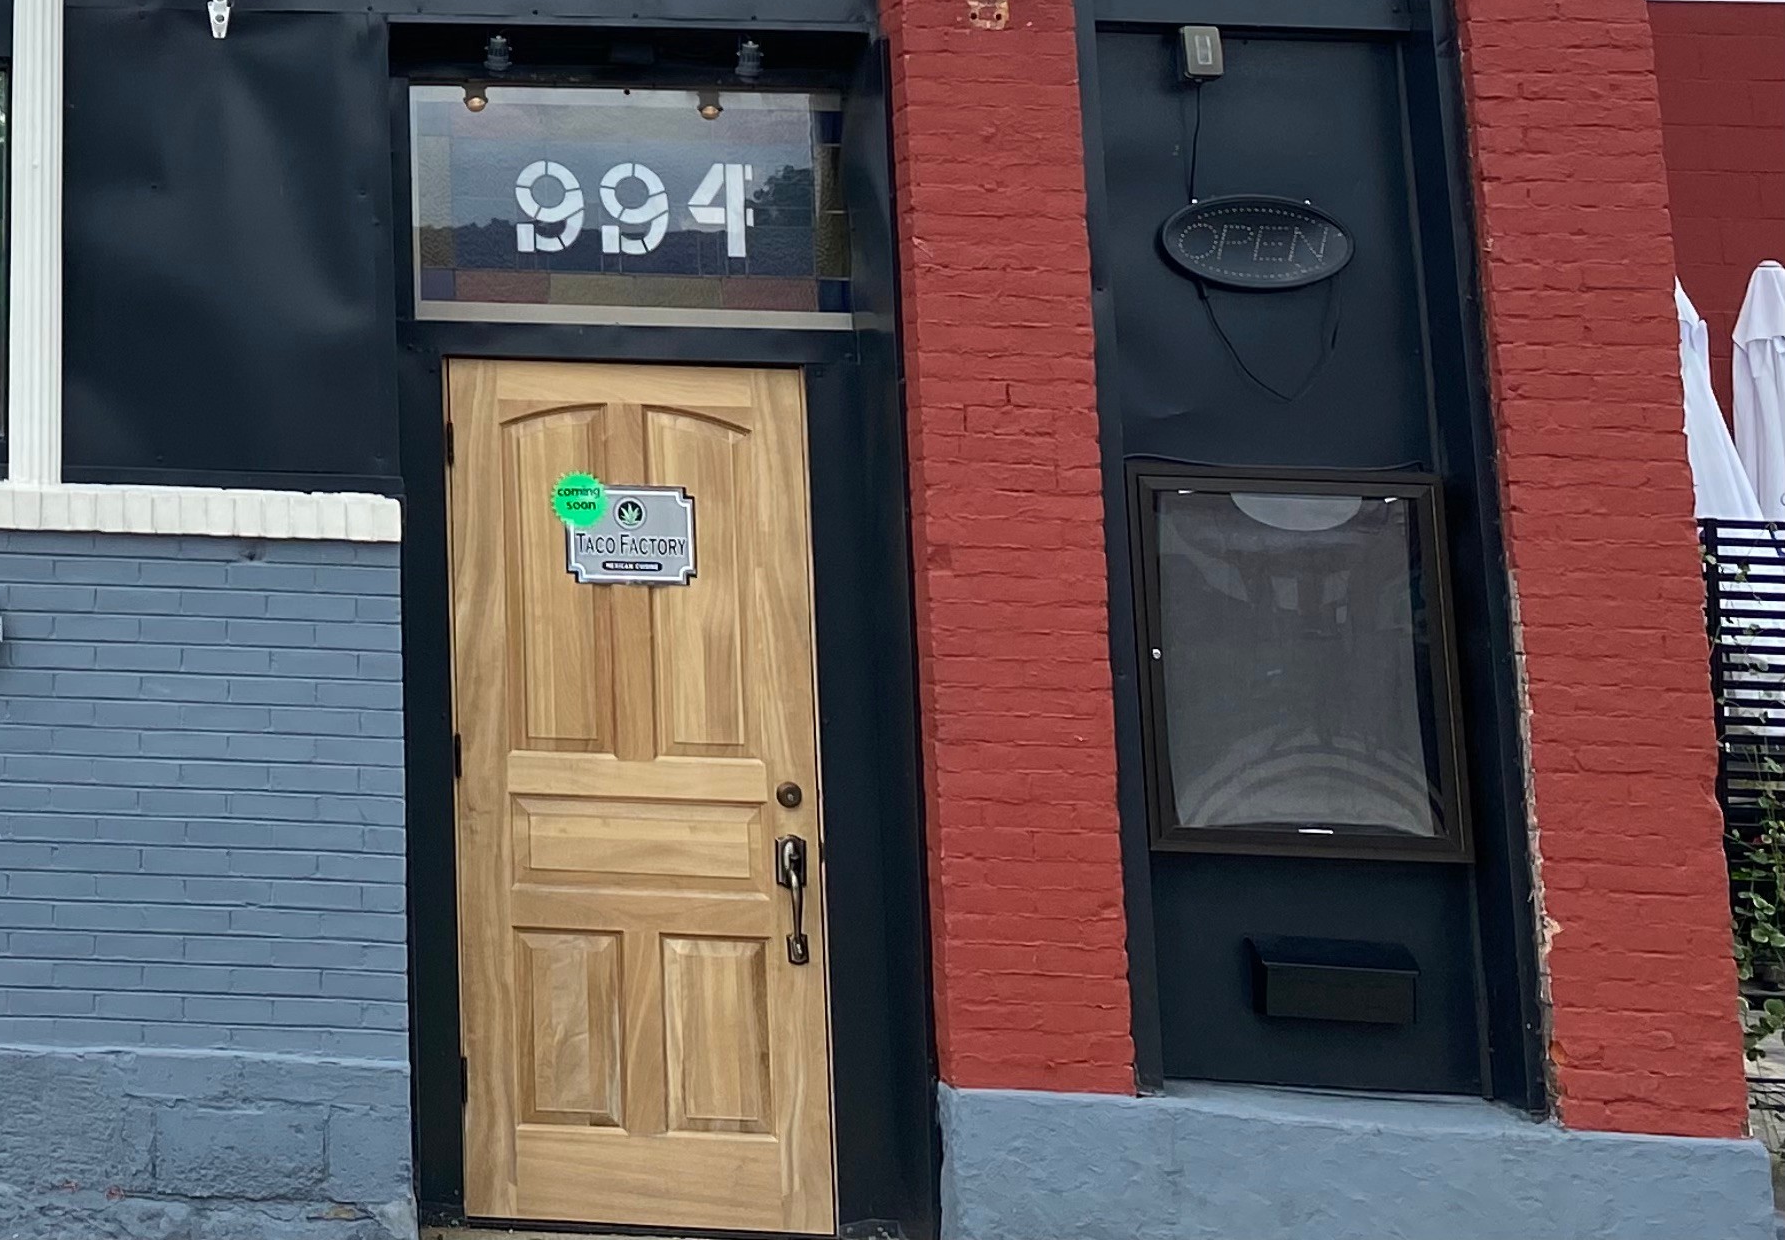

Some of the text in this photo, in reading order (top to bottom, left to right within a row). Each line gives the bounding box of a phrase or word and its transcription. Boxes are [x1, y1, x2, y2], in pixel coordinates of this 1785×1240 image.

[515, 160, 755, 258] 994
[1178, 222, 1329, 263] OPEN
[557, 486, 601, 498] coming
[566, 500, 597, 510] soon
[575, 532, 686, 556] TACO FACTORY
